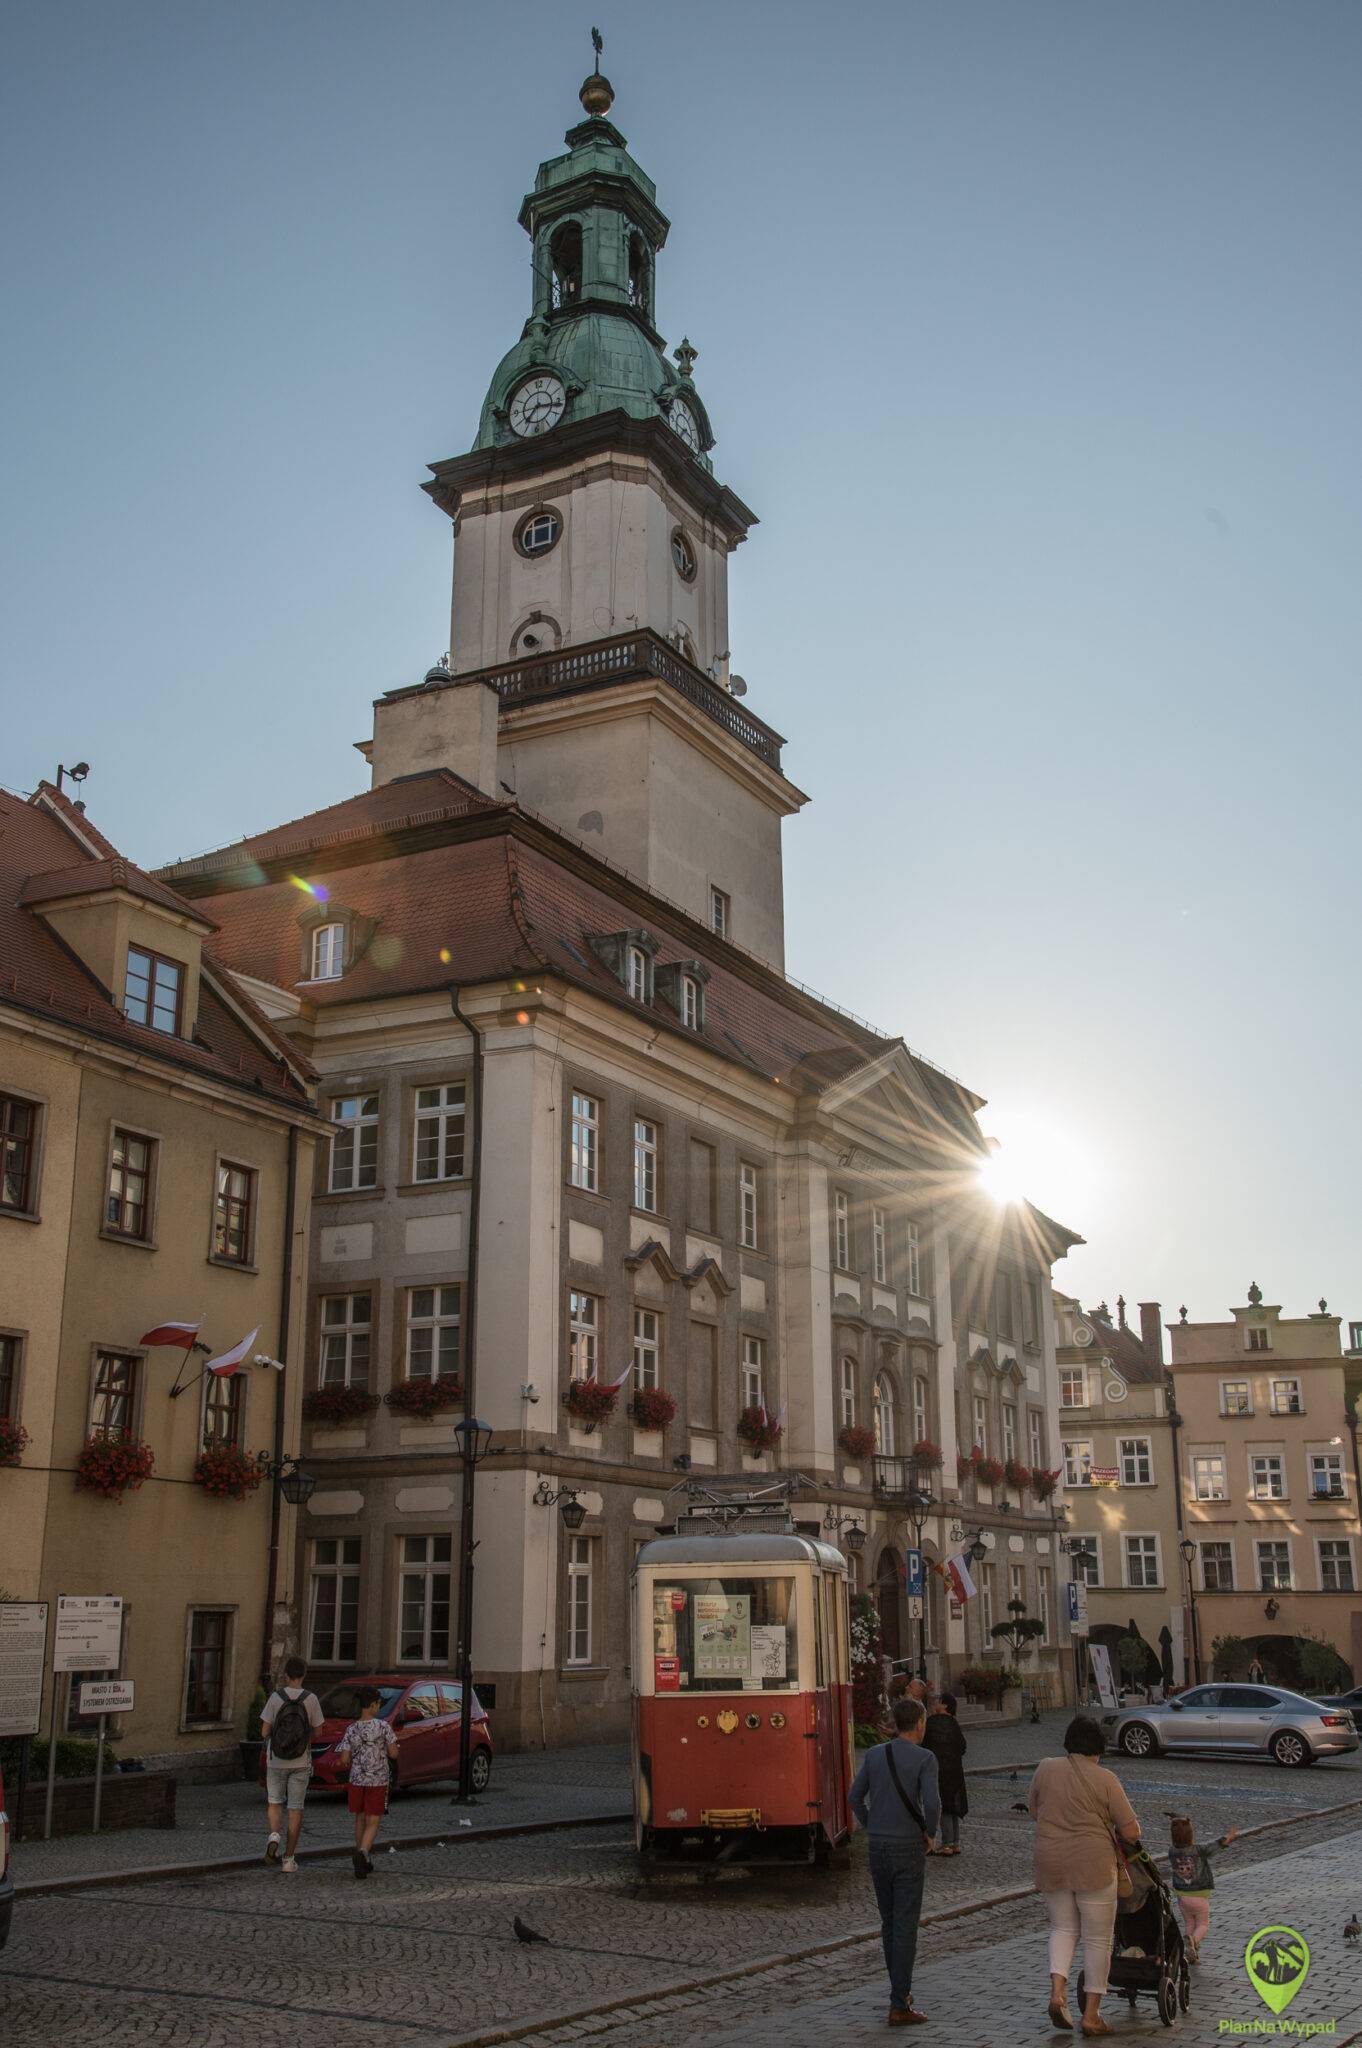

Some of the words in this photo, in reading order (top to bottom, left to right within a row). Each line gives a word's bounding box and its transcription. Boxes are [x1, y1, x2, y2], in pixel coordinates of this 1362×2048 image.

[535, 381, 543, 389] 12
[514, 409, 519, 418] 9
[535, 424, 540, 433] 6
[909, 1553, 919, 1582] P
[1069, 1585, 1077, 1610] P
